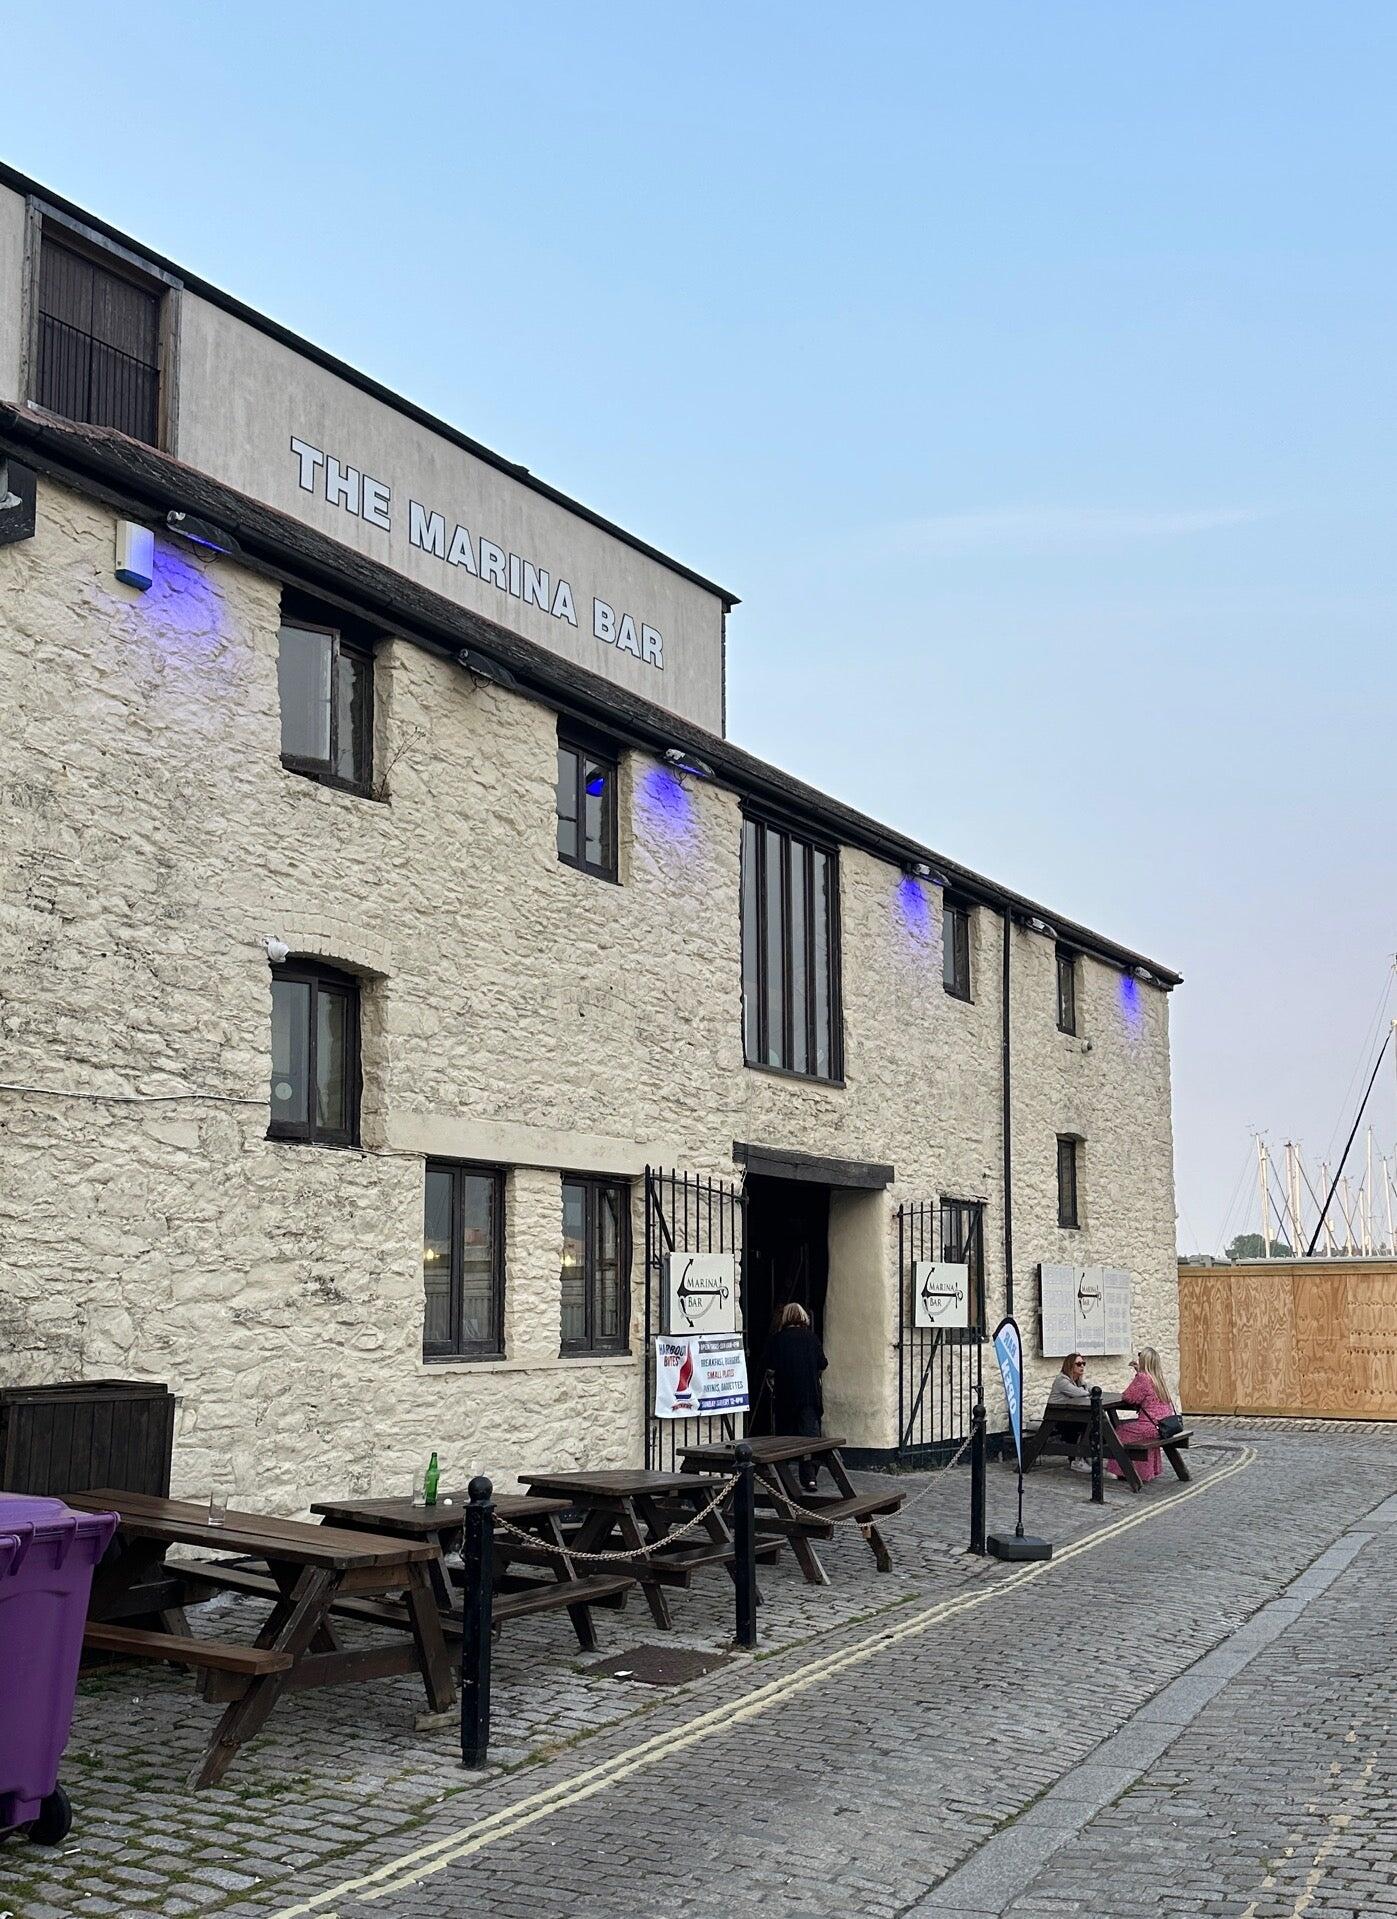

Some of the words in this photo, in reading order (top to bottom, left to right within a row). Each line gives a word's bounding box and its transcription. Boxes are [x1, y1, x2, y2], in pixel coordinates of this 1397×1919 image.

[290, 435, 392, 532] THE
[409, 499, 579, 628] MARINA
[593, 597, 664, 671] BAR
[687, 1276, 719, 1288] MARINA
[929, 1282, 955, 1292] MARINA
[688, 1297, 703, 1308] BAR
[929, 1297, 942, 1307] BAR
[707, 1371, 721, 1379] SMALL
